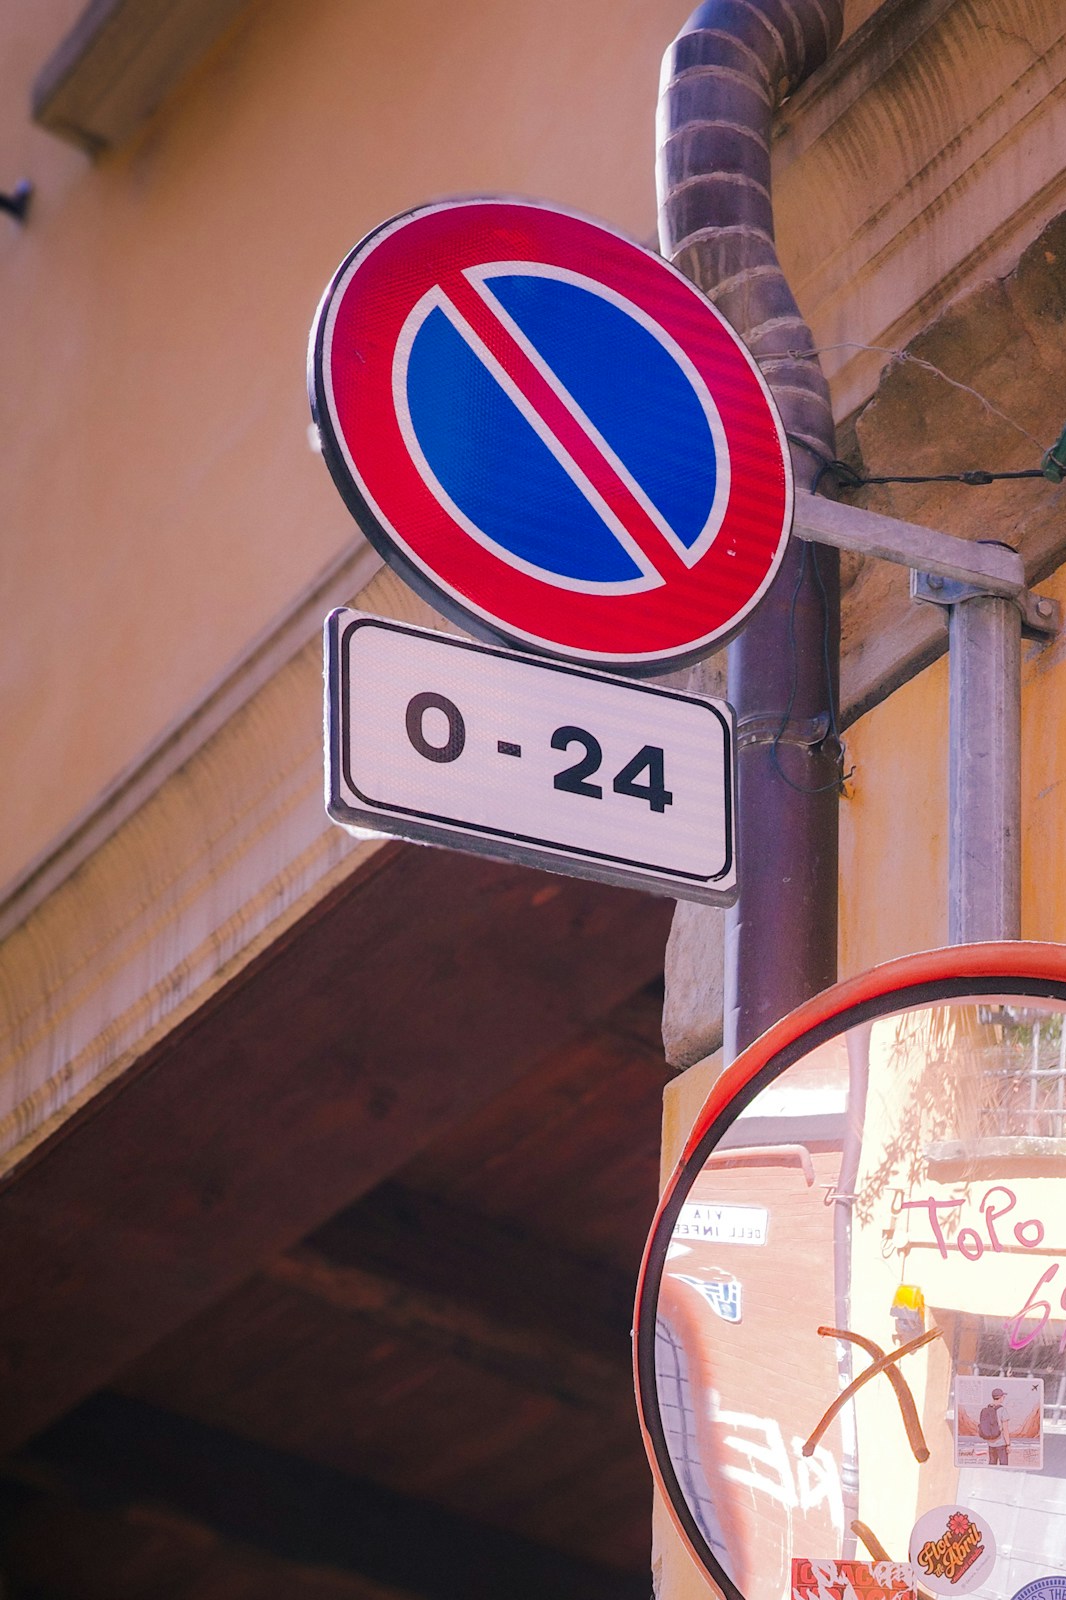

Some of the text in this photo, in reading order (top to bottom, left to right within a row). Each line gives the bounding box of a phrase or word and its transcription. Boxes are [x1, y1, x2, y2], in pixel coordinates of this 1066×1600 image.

[551, 726, 673, 813] 24
[918, 1529, 954, 1575] Flor
[942, 1522, 982, 1578] Abril
